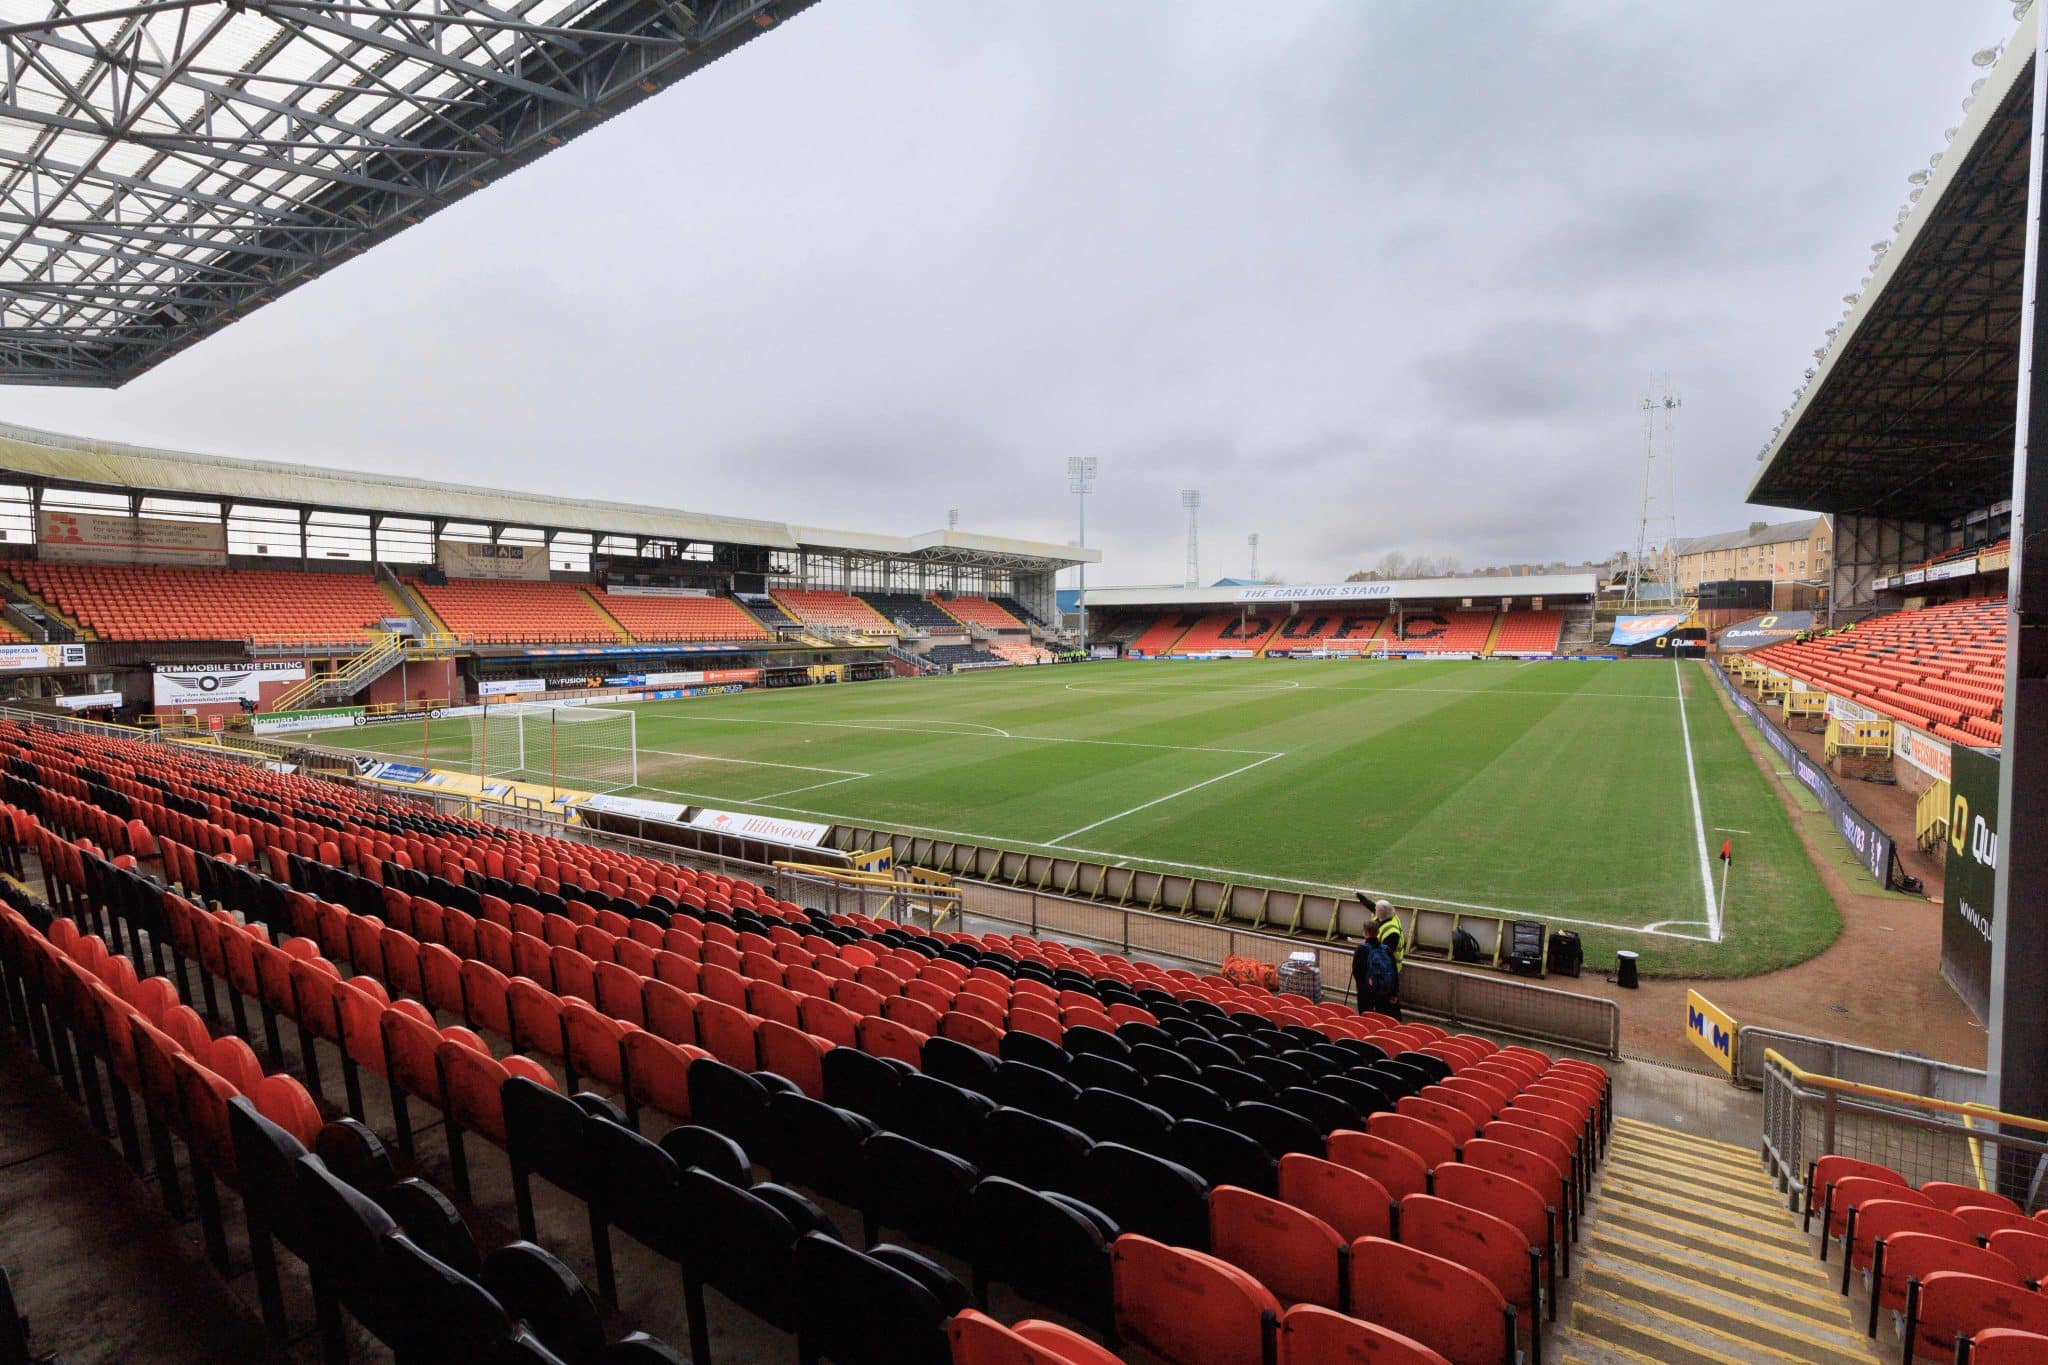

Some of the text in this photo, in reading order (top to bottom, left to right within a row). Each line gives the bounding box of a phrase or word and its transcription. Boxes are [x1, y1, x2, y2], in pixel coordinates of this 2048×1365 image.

[1244, 585, 1391, 598] THE CARLING STAND
[156, 661, 303, 673] RTM MOBILE TYRE FITTING
[251, 716, 294, 726] Norman
[295, 712, 345, 722] Jamieson
[348, 710, 364, 718] Ltd
[742, 818, 817, 841] Hillwood
[1689, 1004, 1729, 1057] MKM
